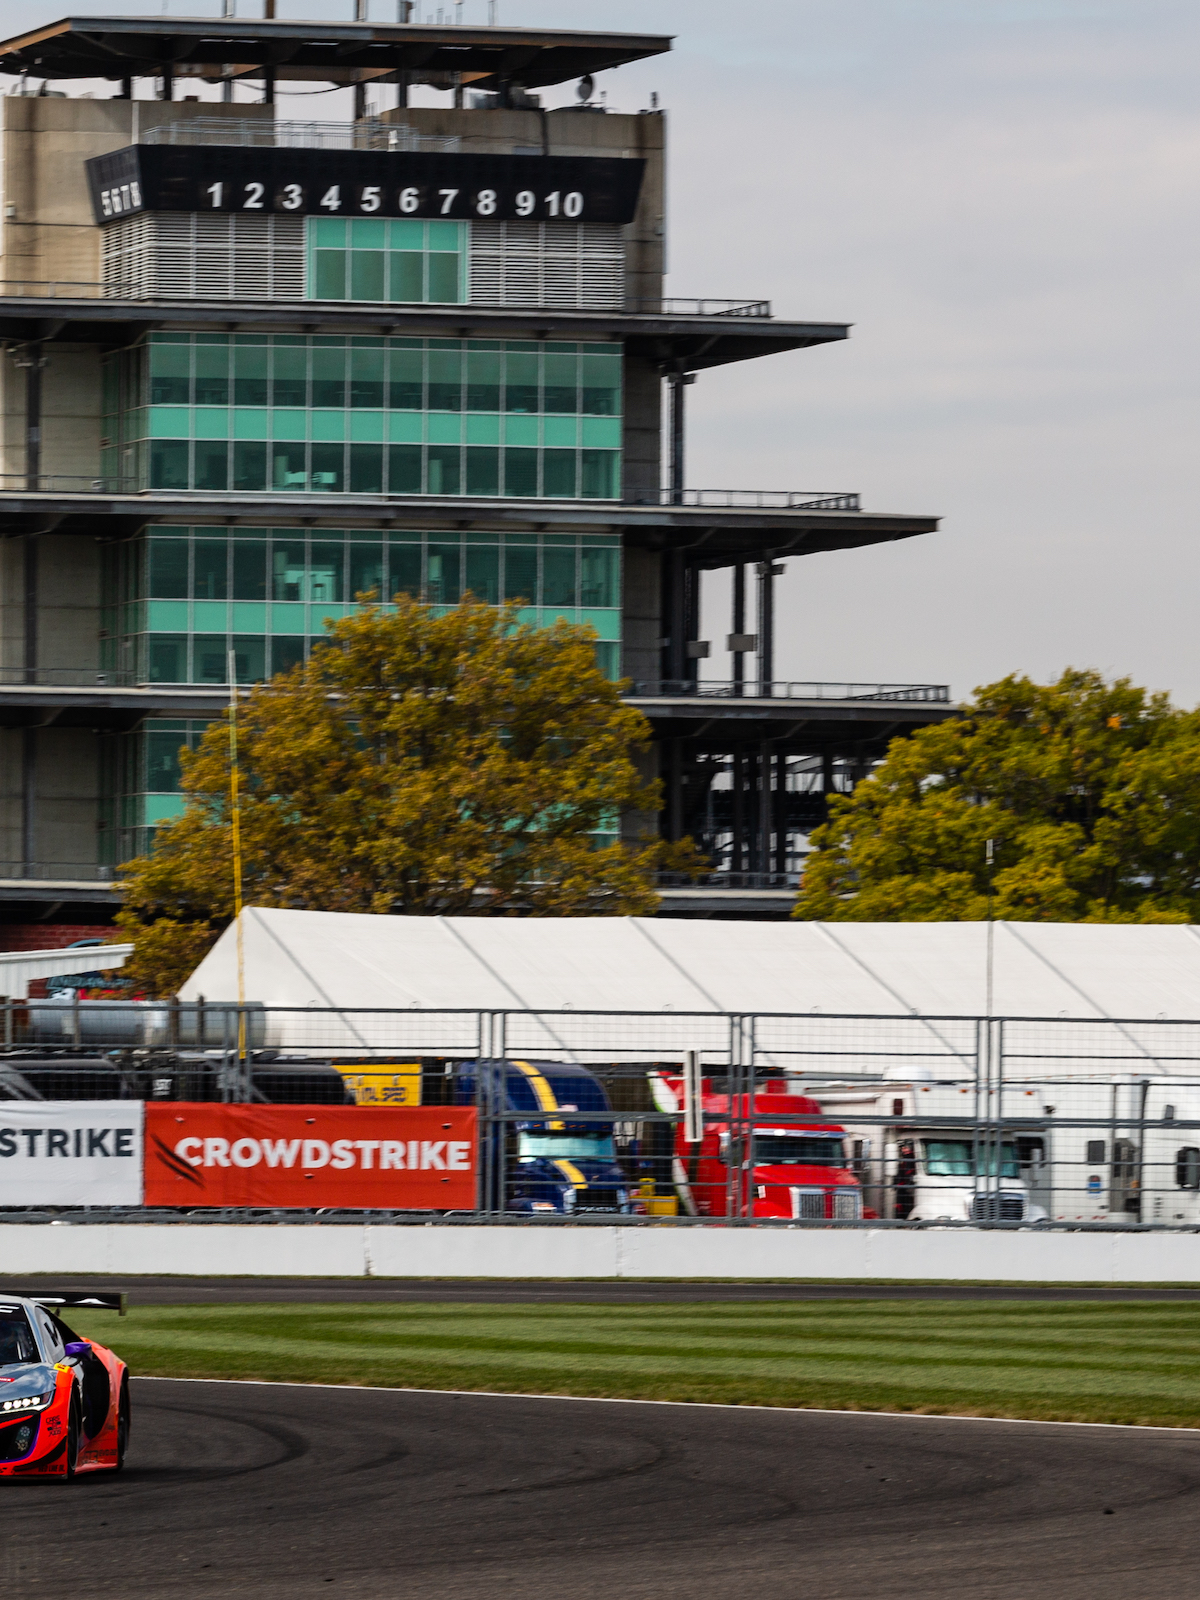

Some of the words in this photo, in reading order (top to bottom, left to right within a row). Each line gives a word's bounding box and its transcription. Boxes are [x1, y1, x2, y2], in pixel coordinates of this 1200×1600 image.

[207, 182, 223, 208] 1
[243, 182, 265, 209] 2
[282, 184, 303, 210] 3
[320, 185, 342, 211] 4
[360, 186, 381, 212] 5
[399, 187, 420, 213] 6
[438, 189, 459, 215] 7
[476, 189, 497, 216] 8
[515, 190, 536, 217] 9
[544, 191, 584, 218] 10
[174, 1137, 472, 1171] CROWDSTRIKE
